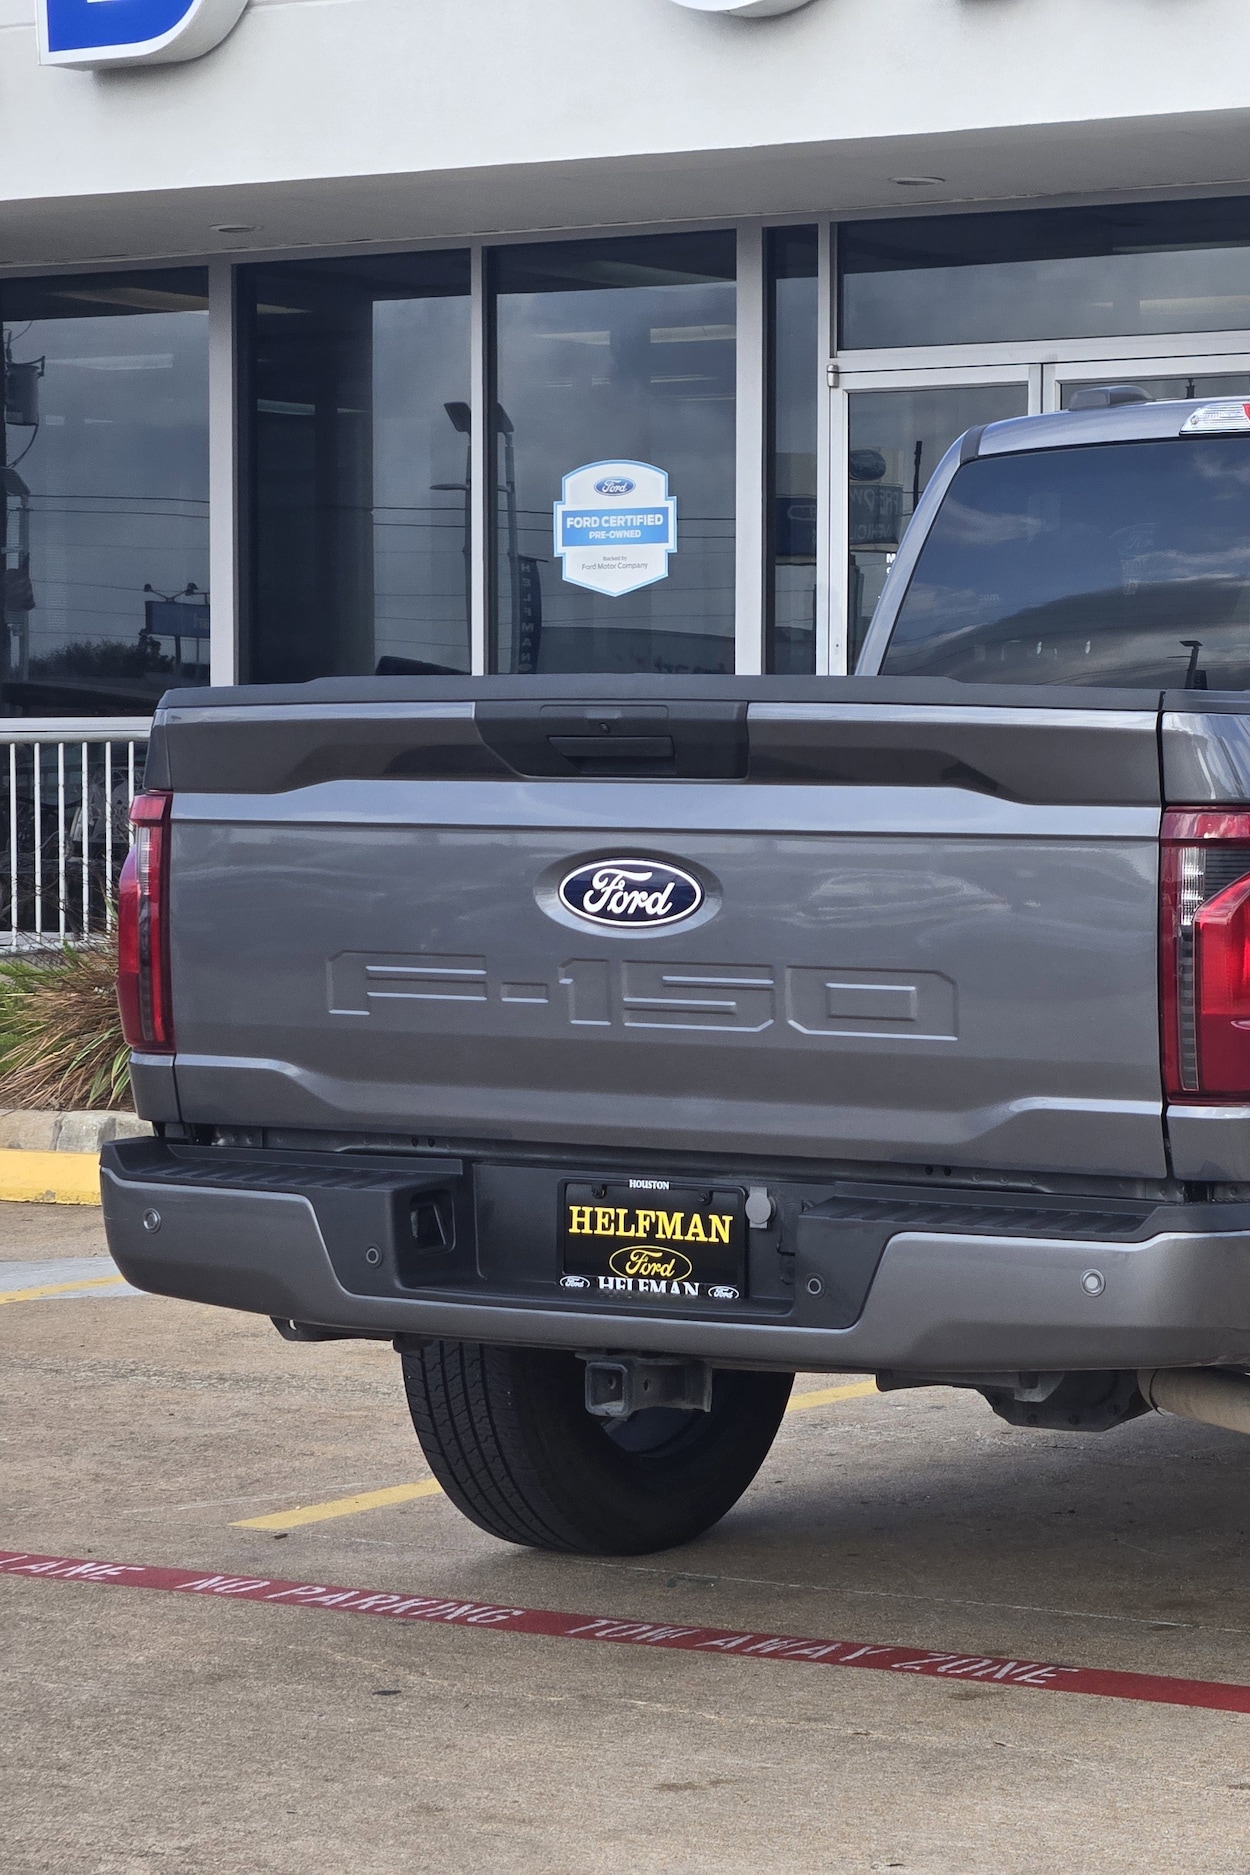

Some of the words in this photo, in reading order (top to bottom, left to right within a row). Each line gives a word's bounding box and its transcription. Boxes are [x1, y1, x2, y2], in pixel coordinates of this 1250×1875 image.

[602, 480, 628, 493] Ford
[566, 517, 599, 528] FORD
[601, 514, 663, 526] CERTIFIED
[588, 529, 642, 540] PRE-OWNED
[581, 563, 597, 571] Ford
[617, 562, 649, 571] Company
[583, 868, 676, 915] Ford
[327, 949, 958, 1042] F-150
[629, 1178, 670, 1191] HOUSTON
[568, 1205, 734, 1245] HELFMAN
[625, 1249, 676, 1277] Ford
[174, 1575, 271, 1594] NO
[264, 1585, 526, 1624] PARKING
[565, 1619, 702, 1642] TOW
[694, 1634, 896, 1662] AWAY
[890, 1652, 1080, 1684] ZONE
